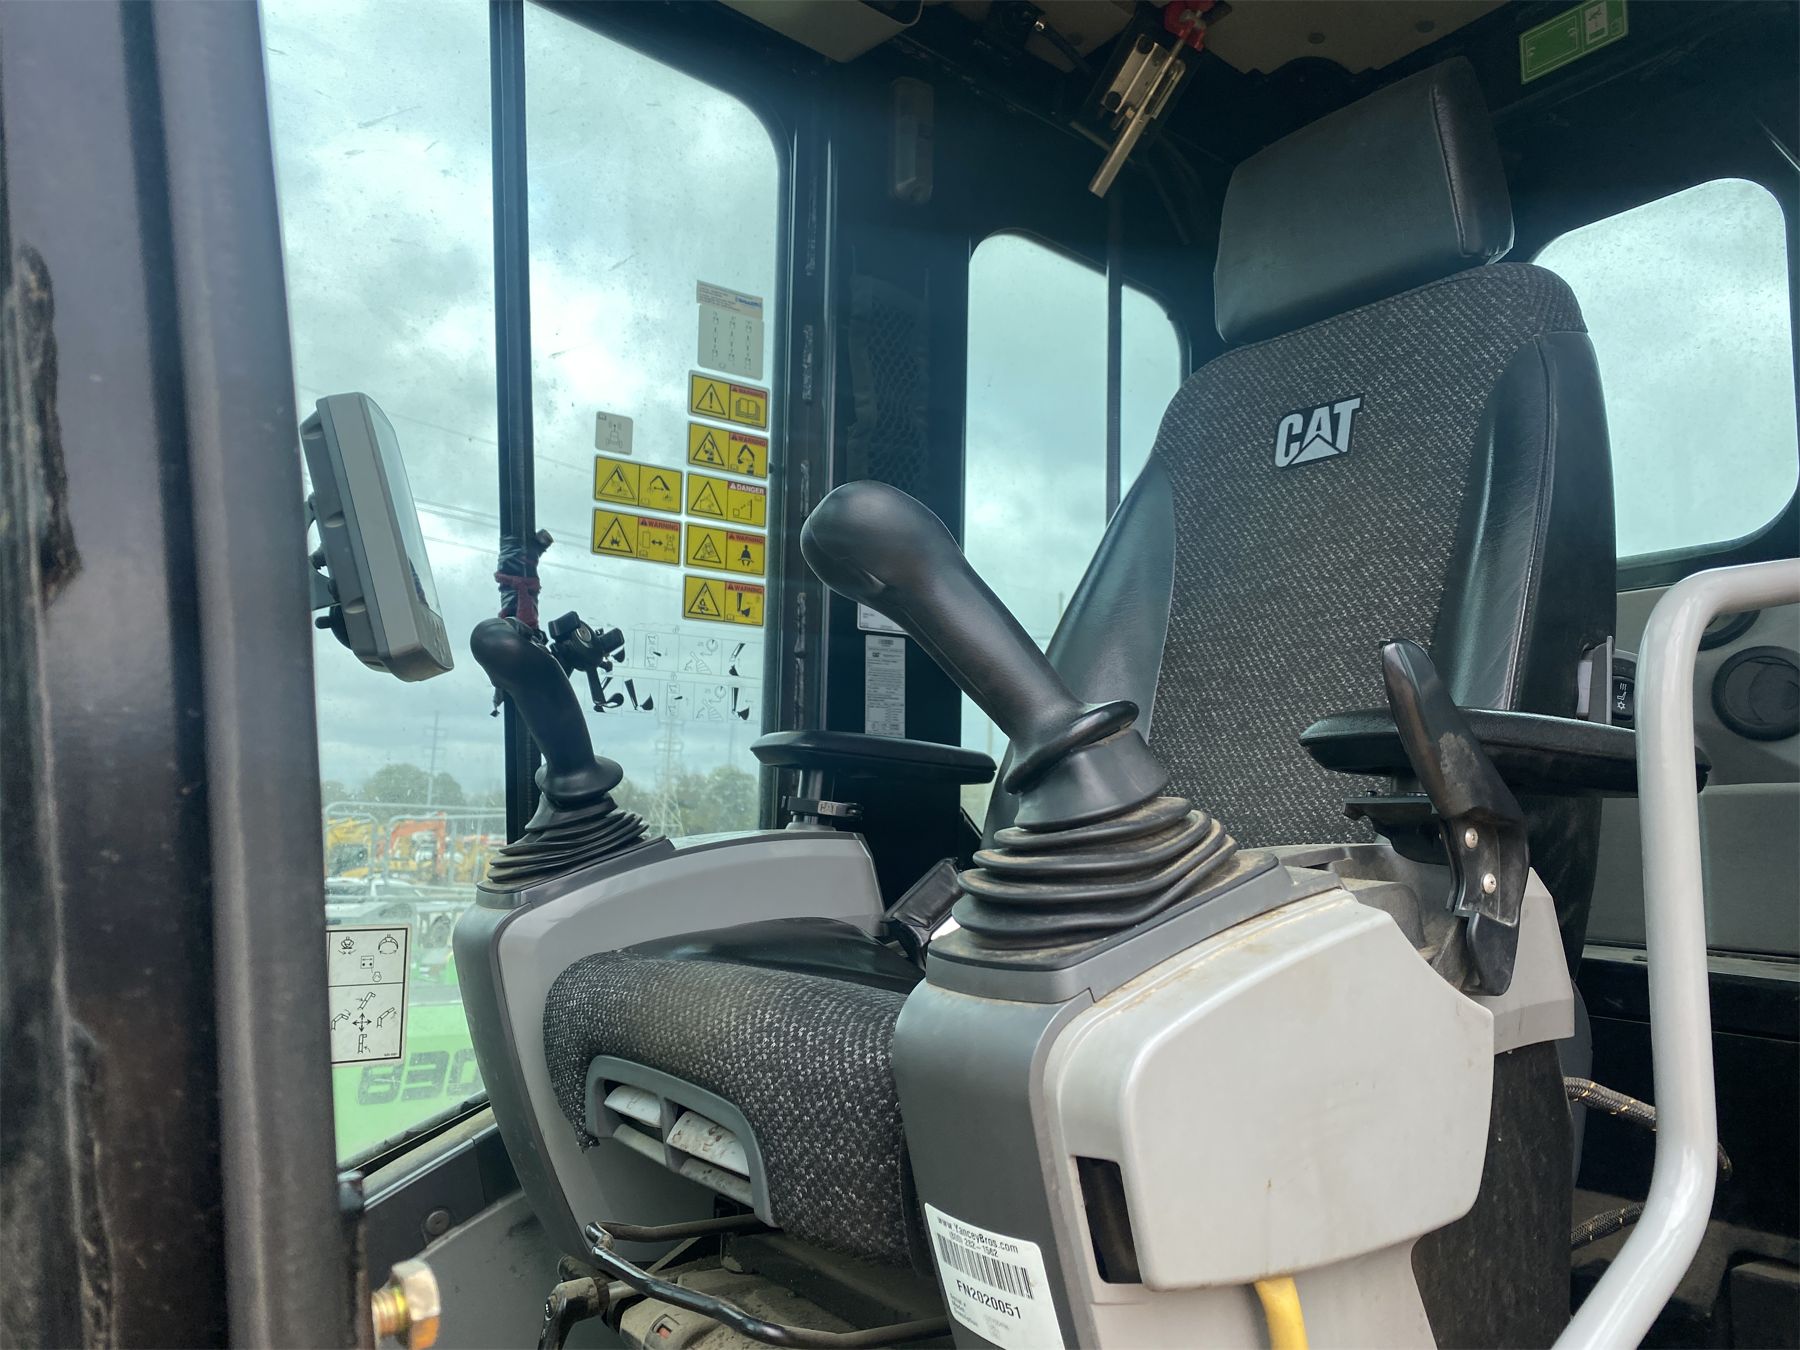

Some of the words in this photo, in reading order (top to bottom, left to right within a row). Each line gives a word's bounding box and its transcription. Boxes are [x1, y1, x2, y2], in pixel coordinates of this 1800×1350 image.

[1275, 397, 1361, 467] CAT
[736, 483, 765, 495] DANGER
[648, 520, 679, 532] WARNING
[956, 1280, 1022, 1319] FN2020051
